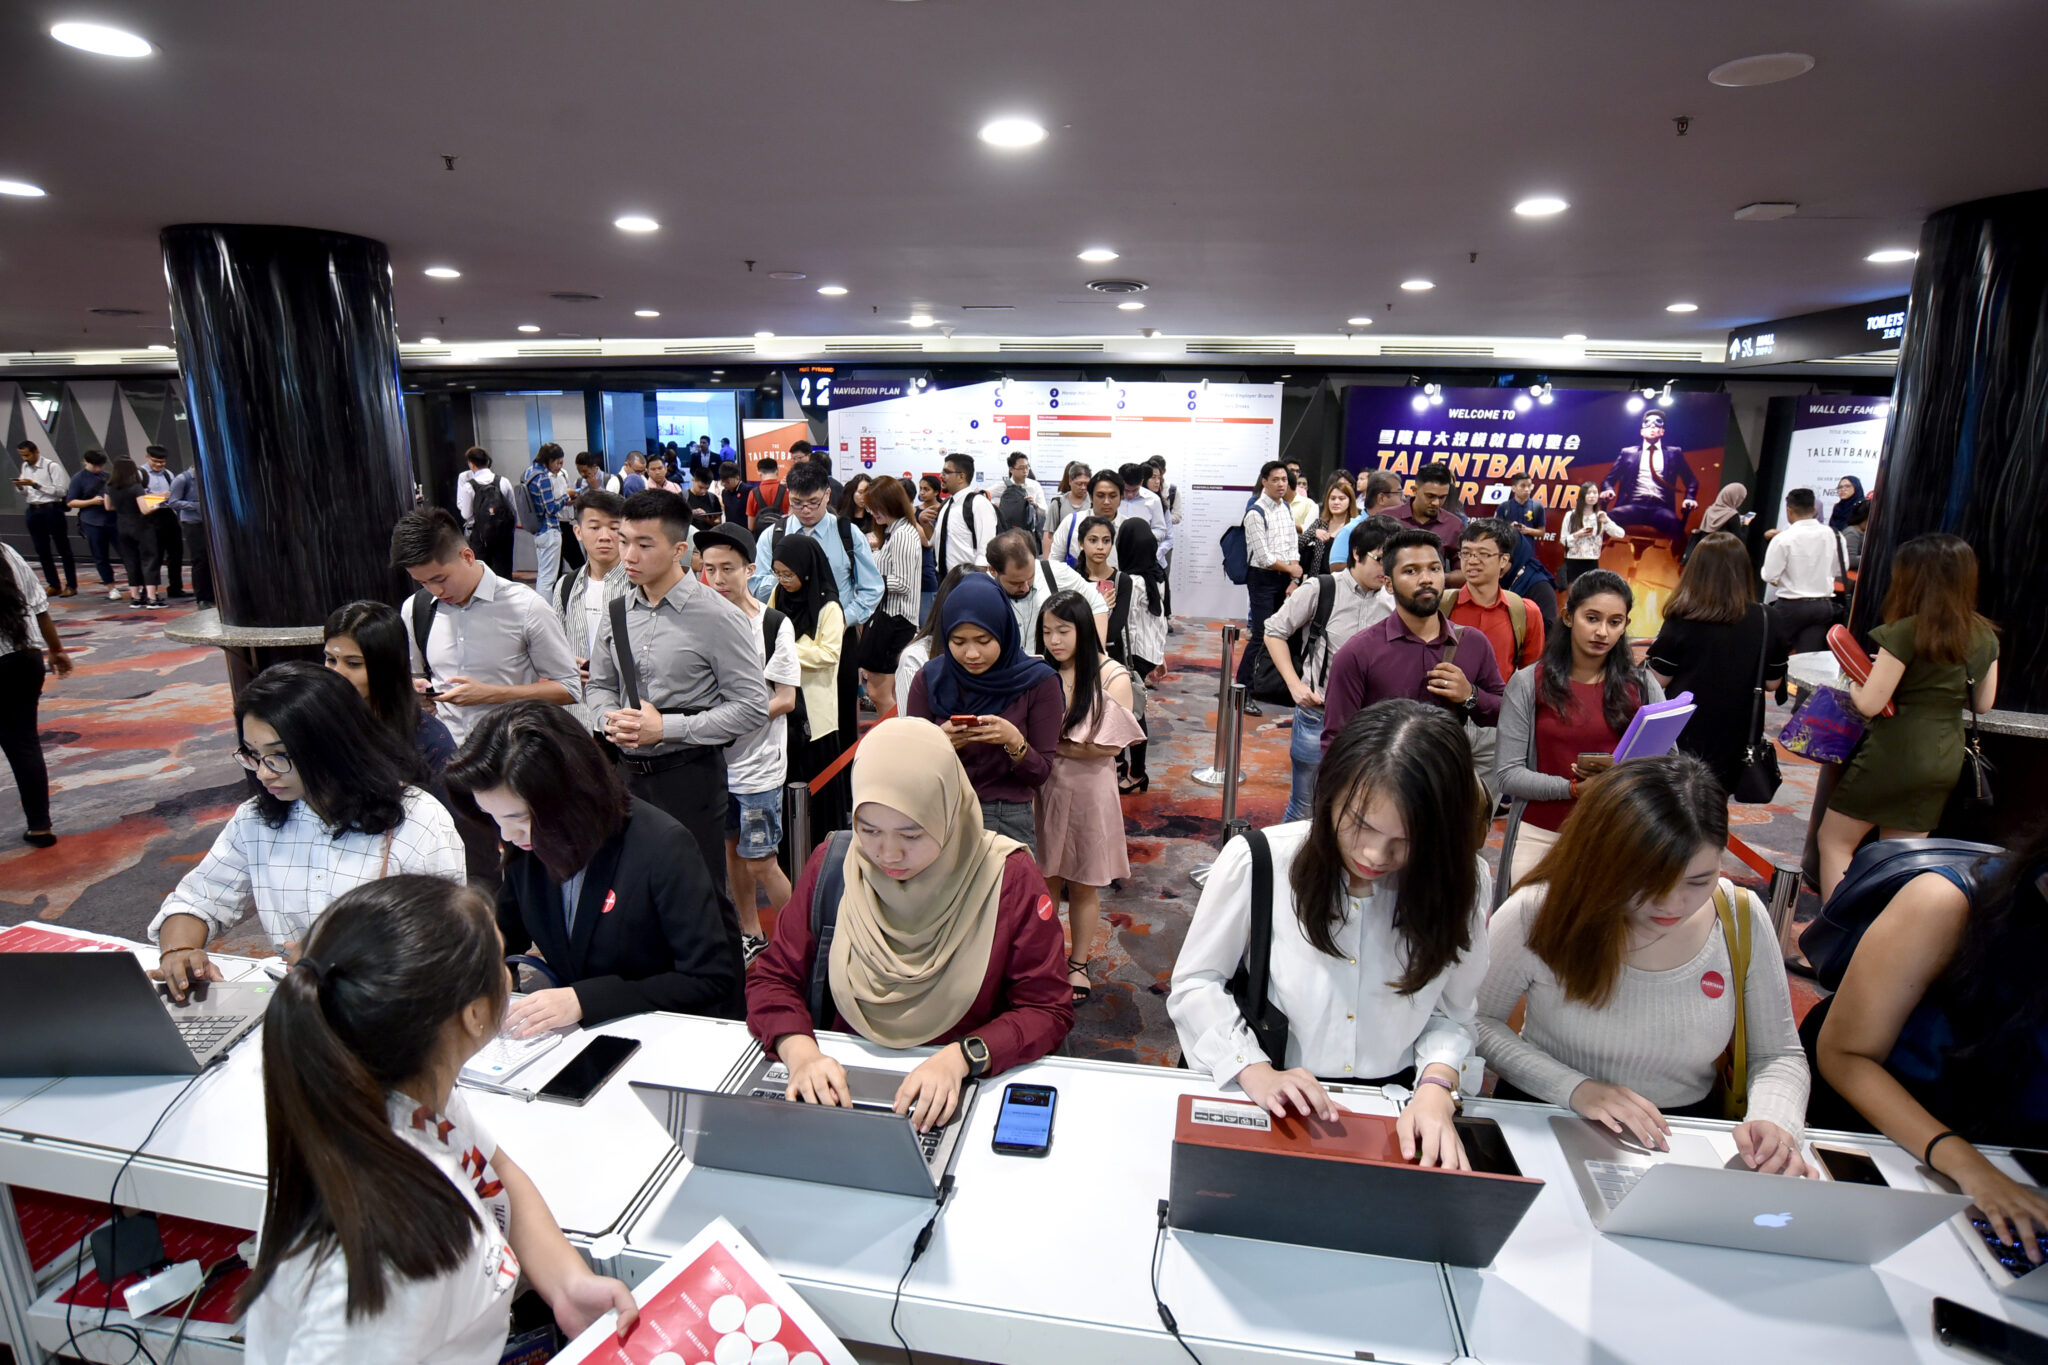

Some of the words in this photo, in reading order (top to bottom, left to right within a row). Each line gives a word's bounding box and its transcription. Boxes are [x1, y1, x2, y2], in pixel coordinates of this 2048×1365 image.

[1867, 312, 1905, 330] TOILETS
[833, 387, 878, 396] NAVIGATION
[879, 387, 900, 396] PLAN
[1448, 408, 1501, 420] WELCOME
[1502, 410, 1516, 420] TO
[1809, 405, 1836, 414] WALL
[1838, 405, 1852, 414] OF
[748, 449, 792, 462] TALENTBA
[1807, 446, 1879, 459] TALENTBANK
[1532, 484, 1581, 509] AIR
